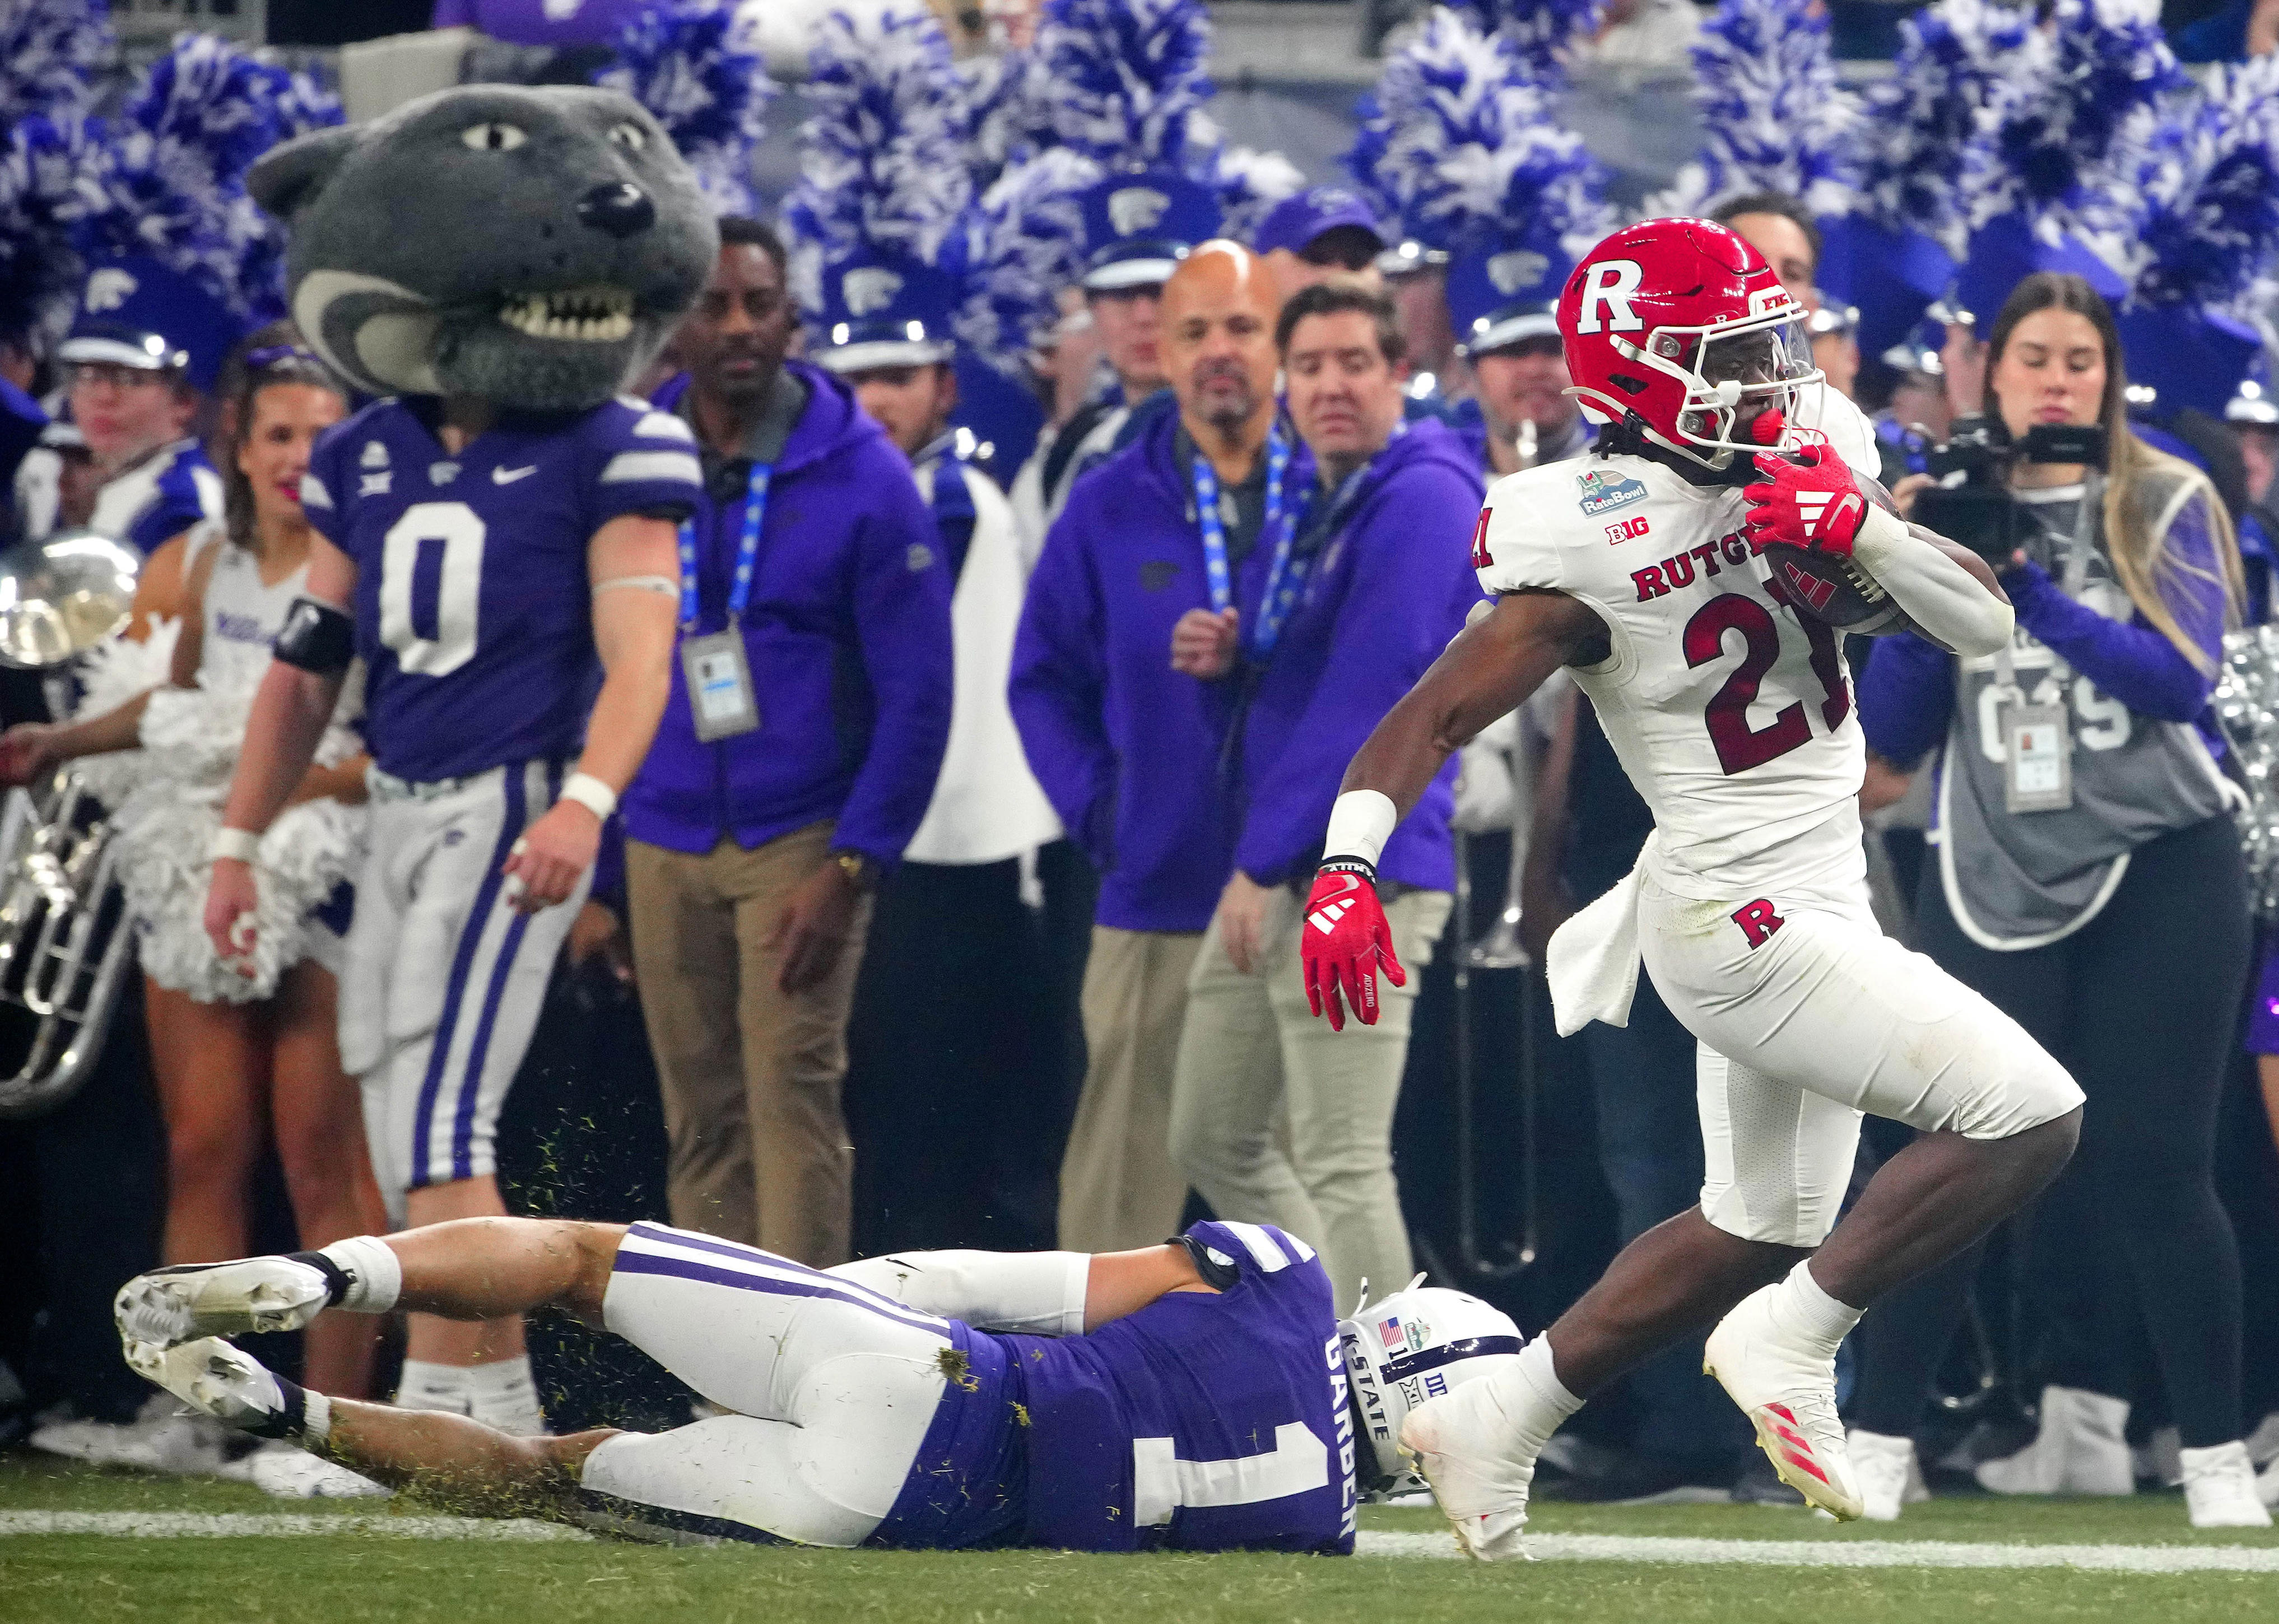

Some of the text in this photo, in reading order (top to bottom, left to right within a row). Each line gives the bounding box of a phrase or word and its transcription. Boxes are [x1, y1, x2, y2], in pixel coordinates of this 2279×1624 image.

[1576, 259, 1644, 335] R
[379, 501, 487, 677] 0
[1730, 899, 1785, 950] R
[1341, 1333, 1390, 1441] K-STATE
[1134, 1421, 1329, 1528] 1
